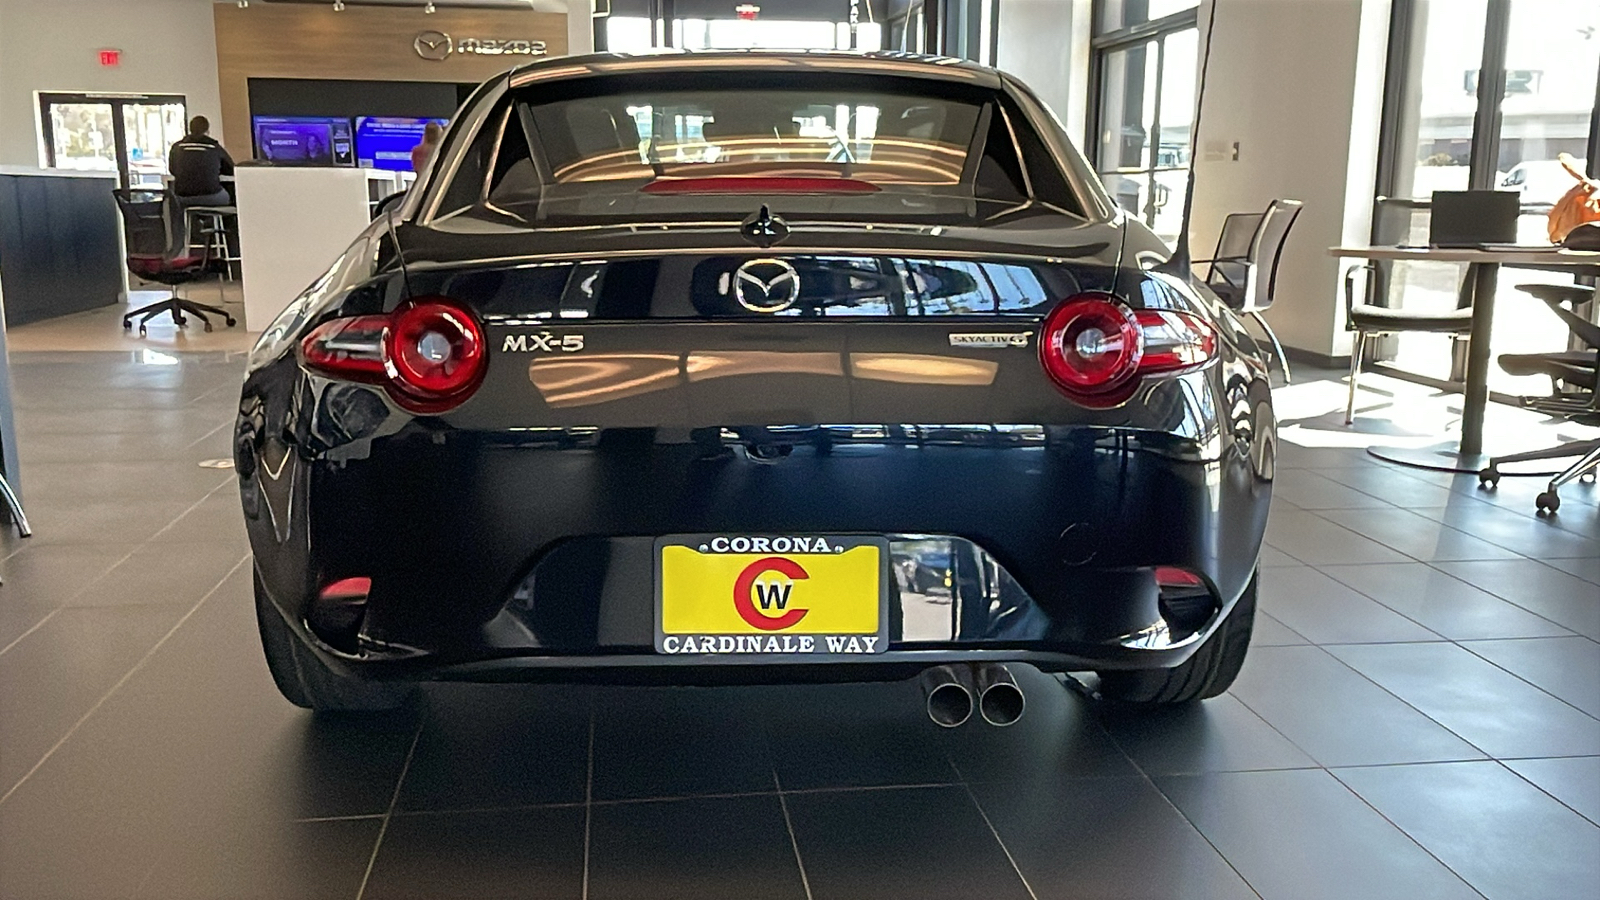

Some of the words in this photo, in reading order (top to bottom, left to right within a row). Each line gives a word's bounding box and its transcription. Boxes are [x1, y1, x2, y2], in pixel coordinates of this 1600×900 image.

[502, 334, 584, 353] MX-5
[711, 537, 831, 553] CORONA
[662, 636, 815, 654] CARDINALE
[825, 636, 879, 654] WAY
